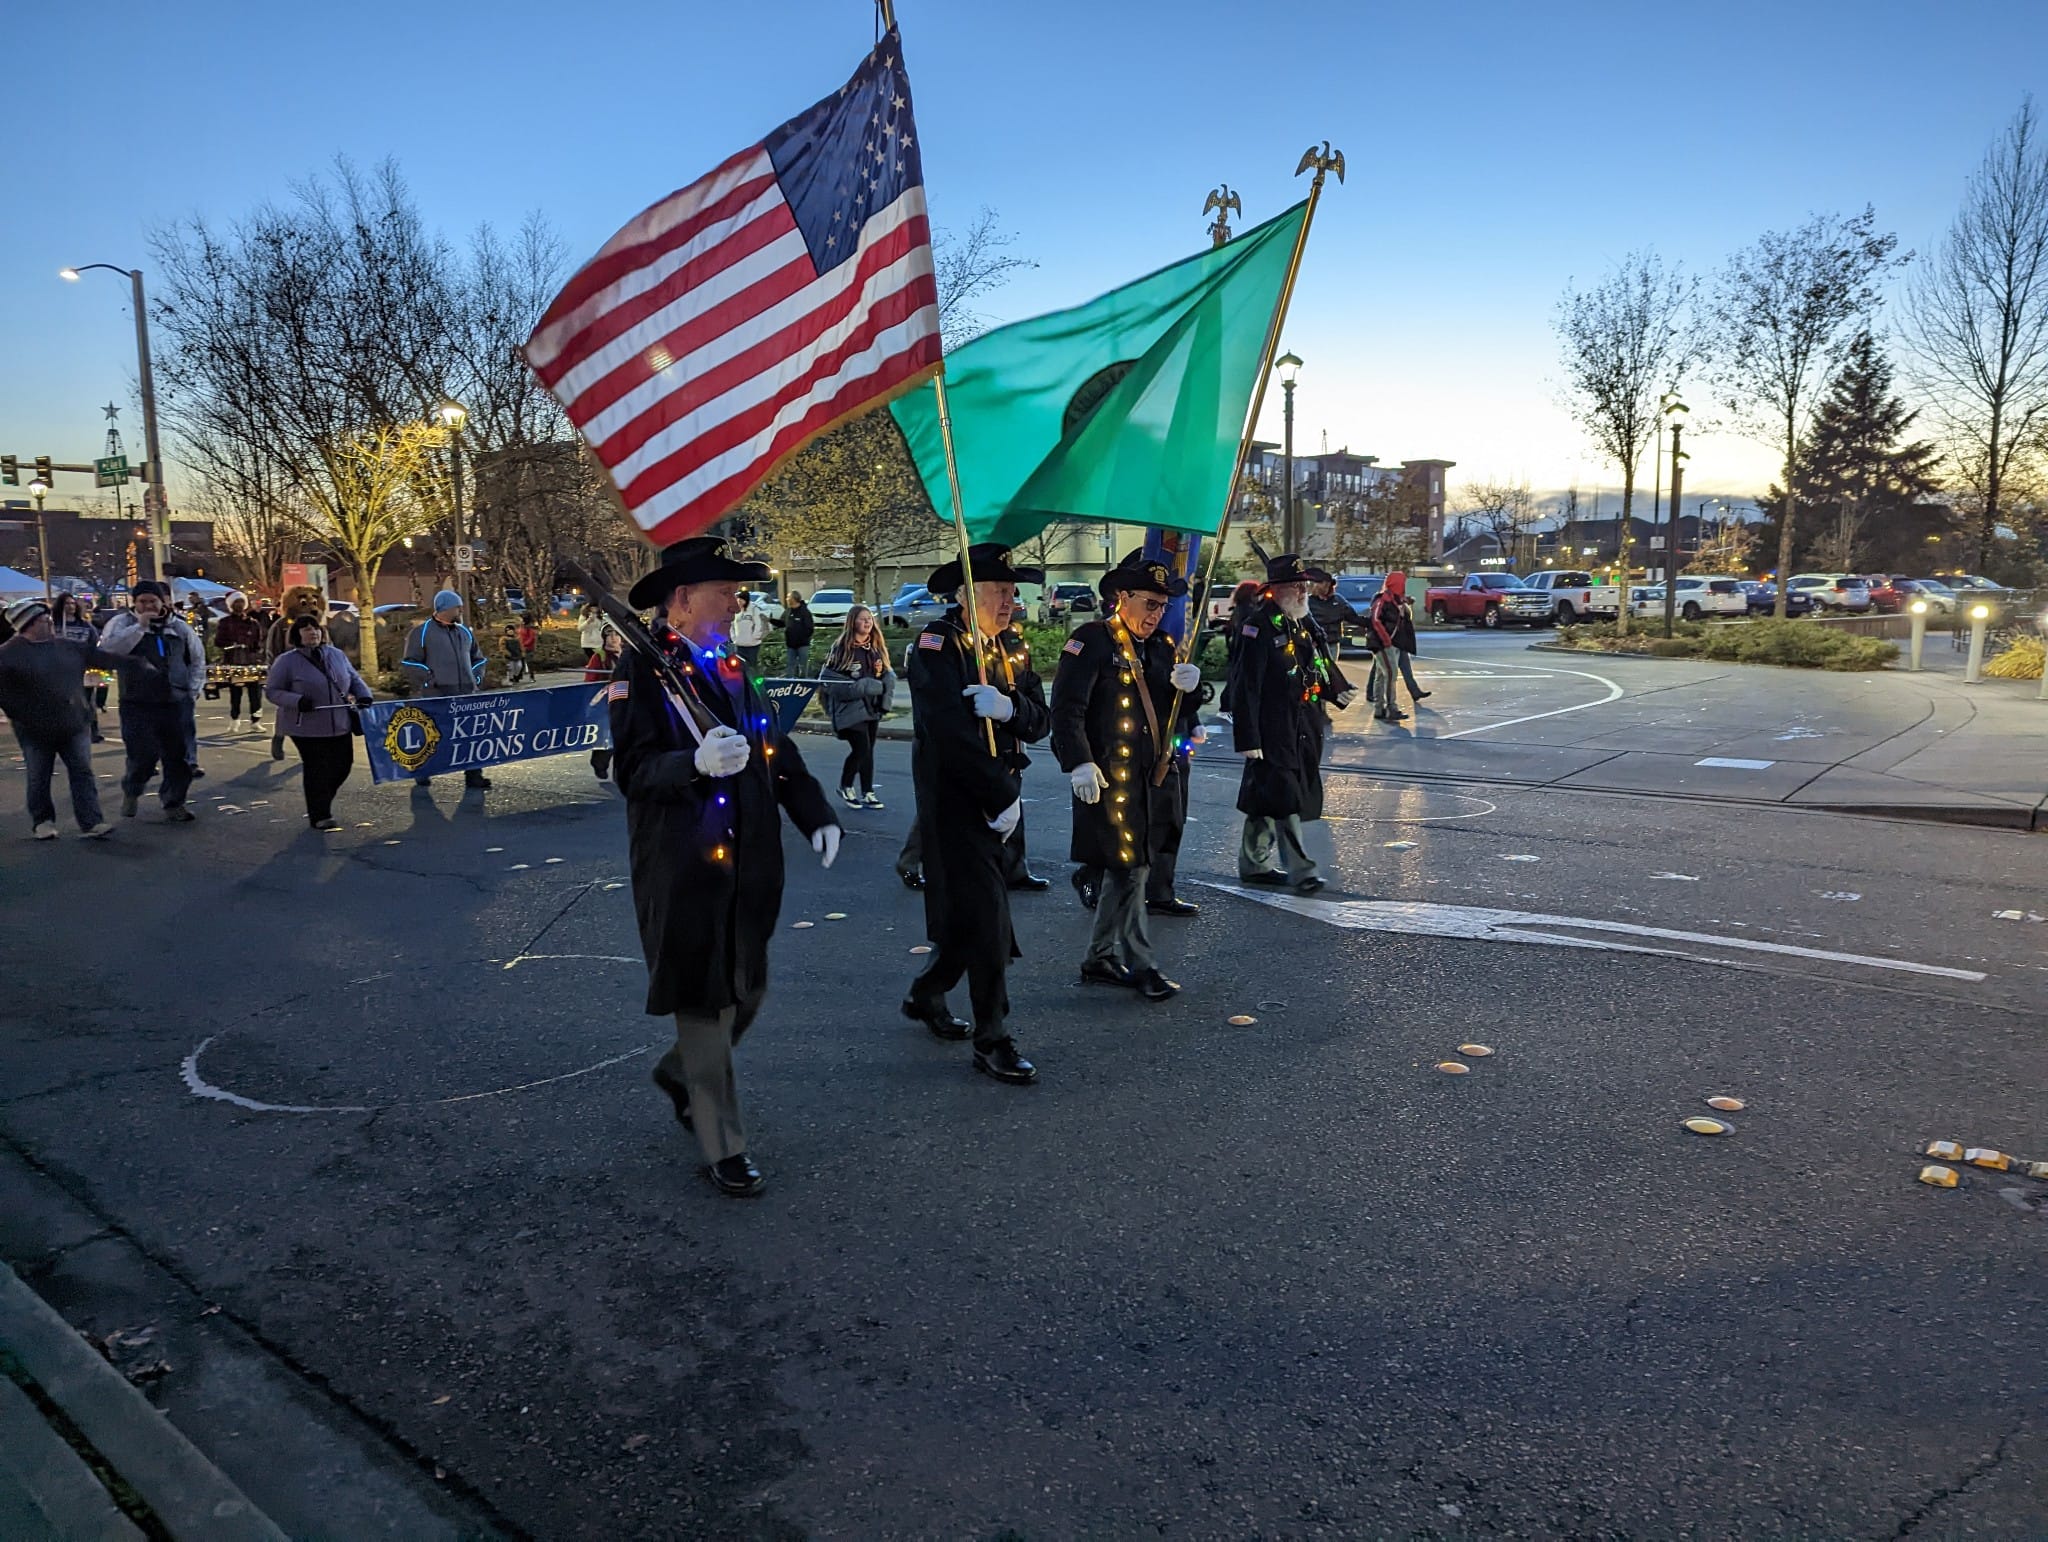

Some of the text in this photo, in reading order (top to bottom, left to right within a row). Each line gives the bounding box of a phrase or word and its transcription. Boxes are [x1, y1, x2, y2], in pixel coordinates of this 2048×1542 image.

[793, 683, 812, 697] by
[448, 696, 510, 715] Sponsored by
[449, 708, 524, 740] KENT
[403, 725, 421, 750] L
[449, 733, 525, 766] LIONS
[532, 724, 599, 752] CLUB
